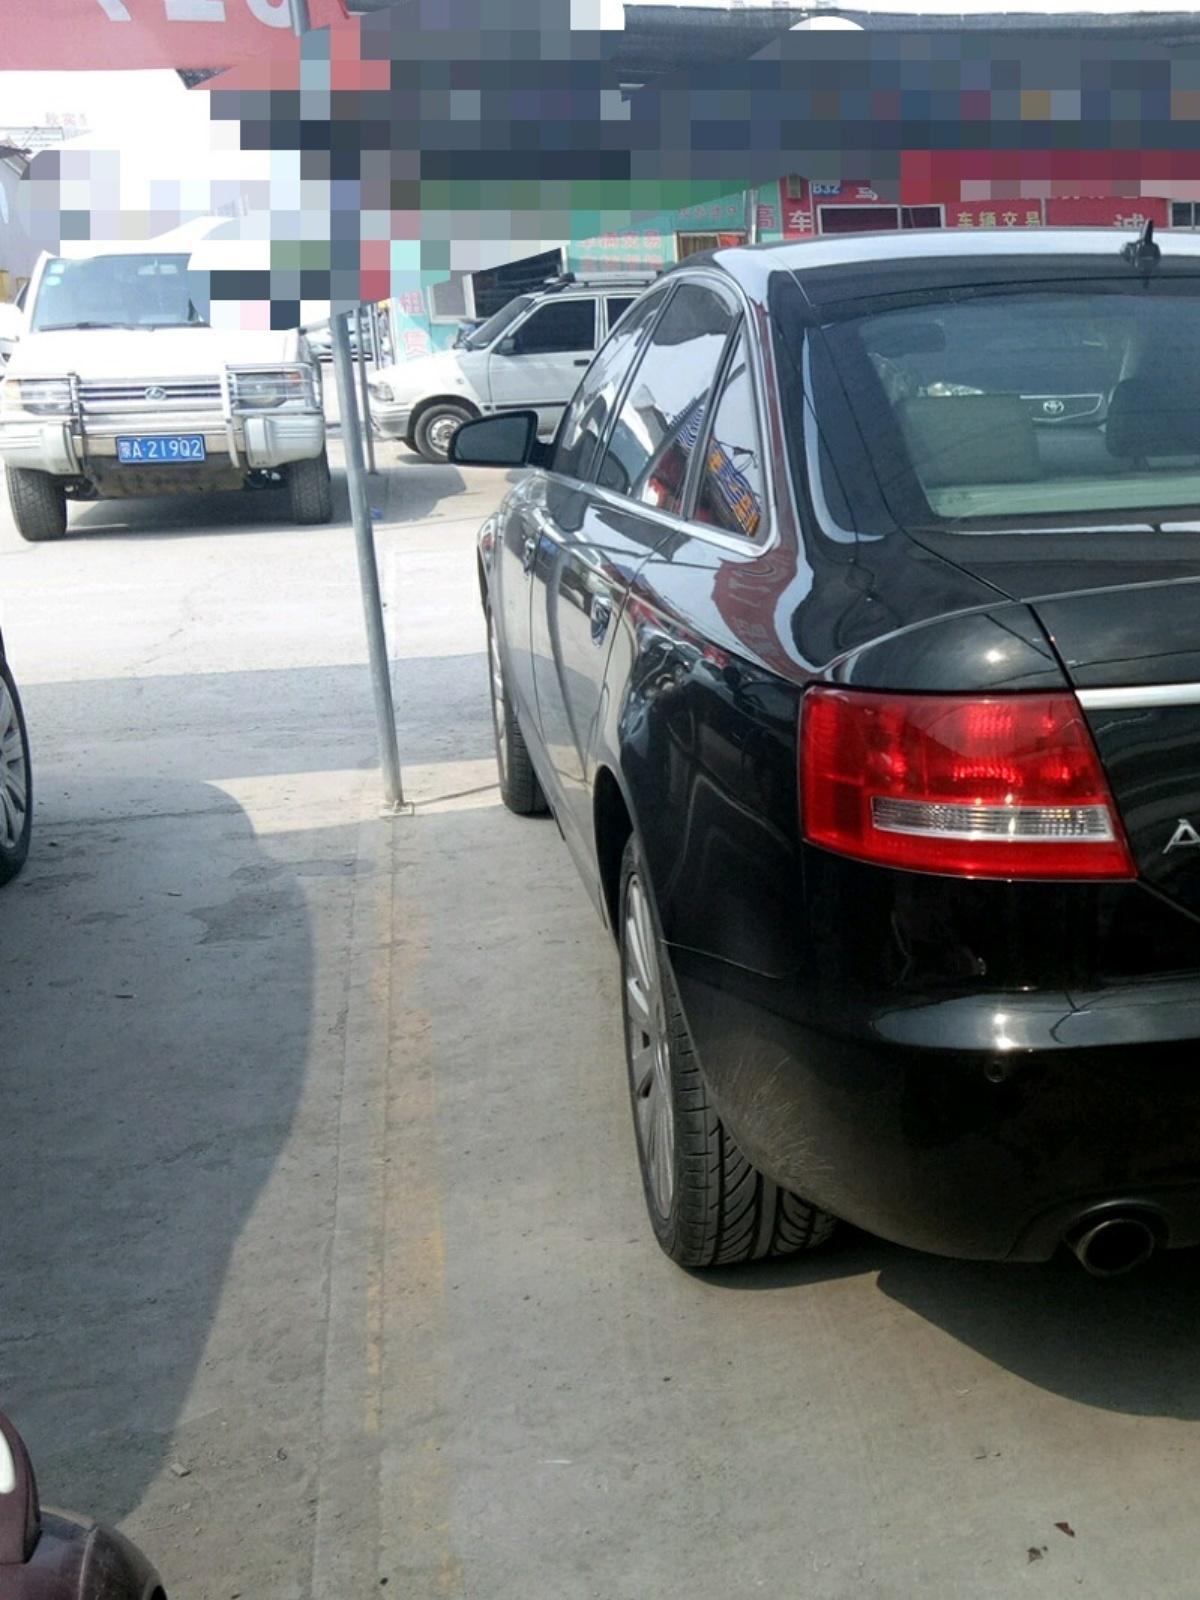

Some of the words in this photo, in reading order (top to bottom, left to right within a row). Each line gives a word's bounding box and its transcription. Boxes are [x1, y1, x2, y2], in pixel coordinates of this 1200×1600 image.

[788, 210, 811, 232] 车
[957, 211, 1040, 227] 车辆交易
